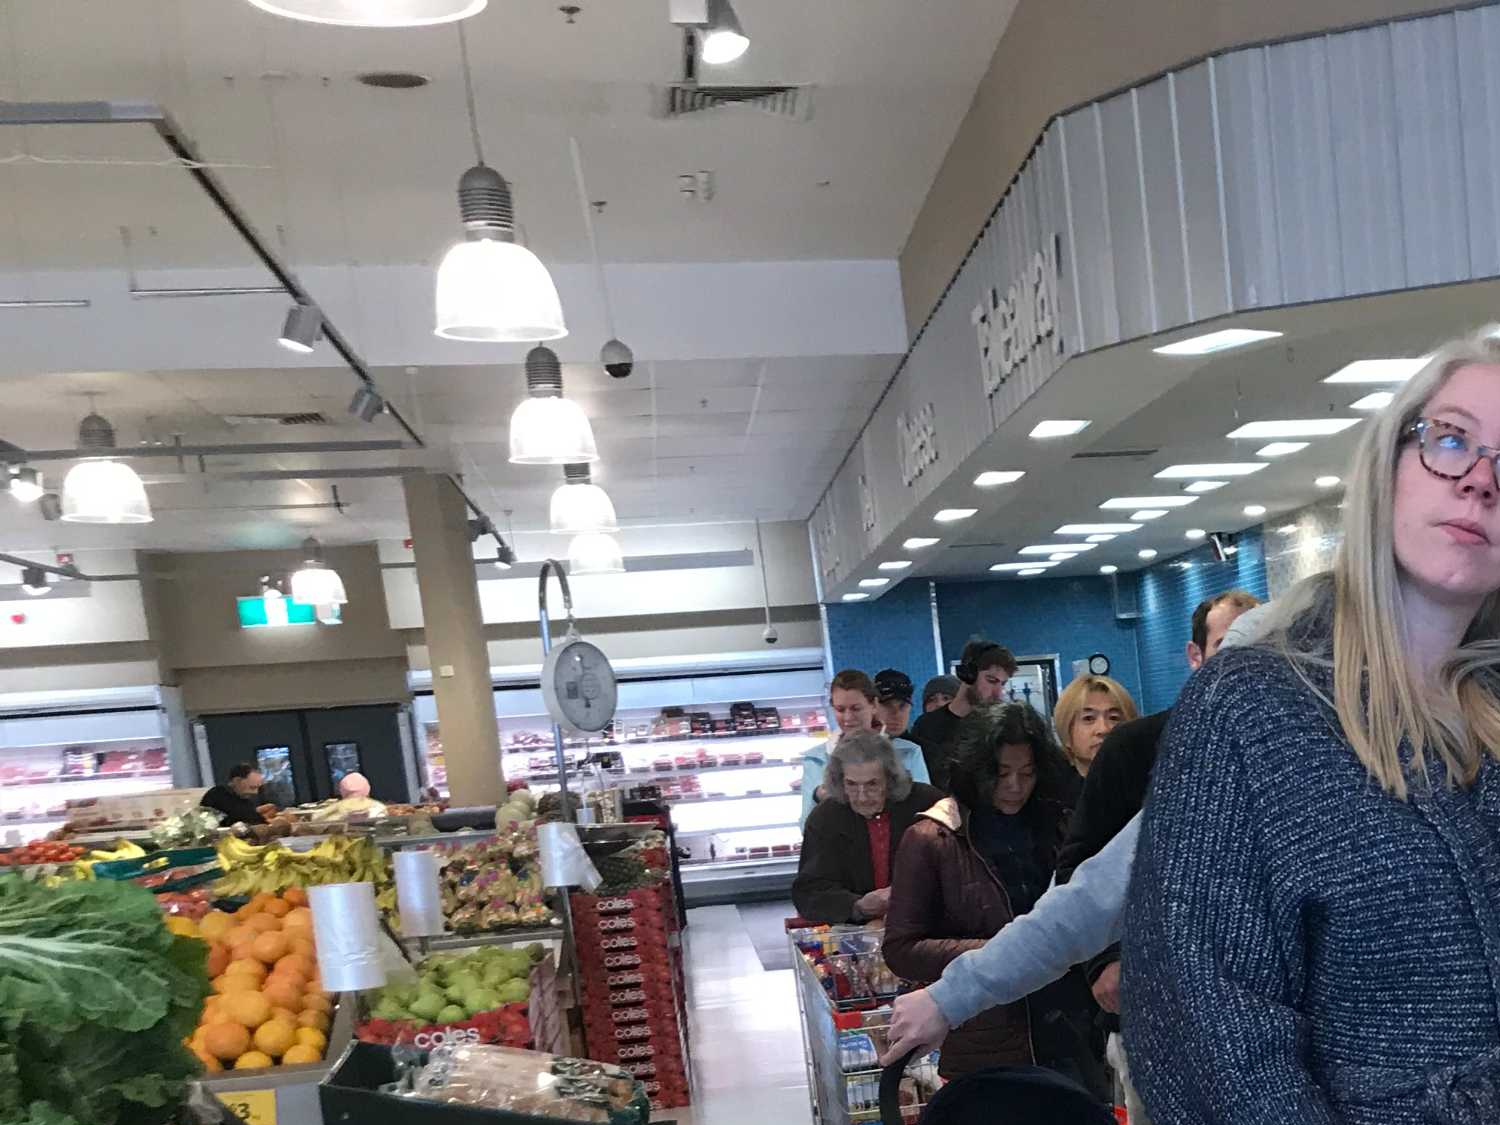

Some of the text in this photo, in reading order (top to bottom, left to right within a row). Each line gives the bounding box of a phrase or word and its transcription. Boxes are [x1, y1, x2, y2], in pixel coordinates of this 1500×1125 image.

[596, 898, 634, 911] coles
[598, 916, 636, 929] coles
[601, 935, 638, 949] coles
[604, 953, 641, 967] coles
[607, 972, 645, 986] coles
[608, 989, 646, 1003] coles
[611, 1007, 649, 1021] coles
[414, 1026, 480, 1049] coles
[614, 1024, 652, 1038] coles
[617, 1043, 655, 1057] coles
